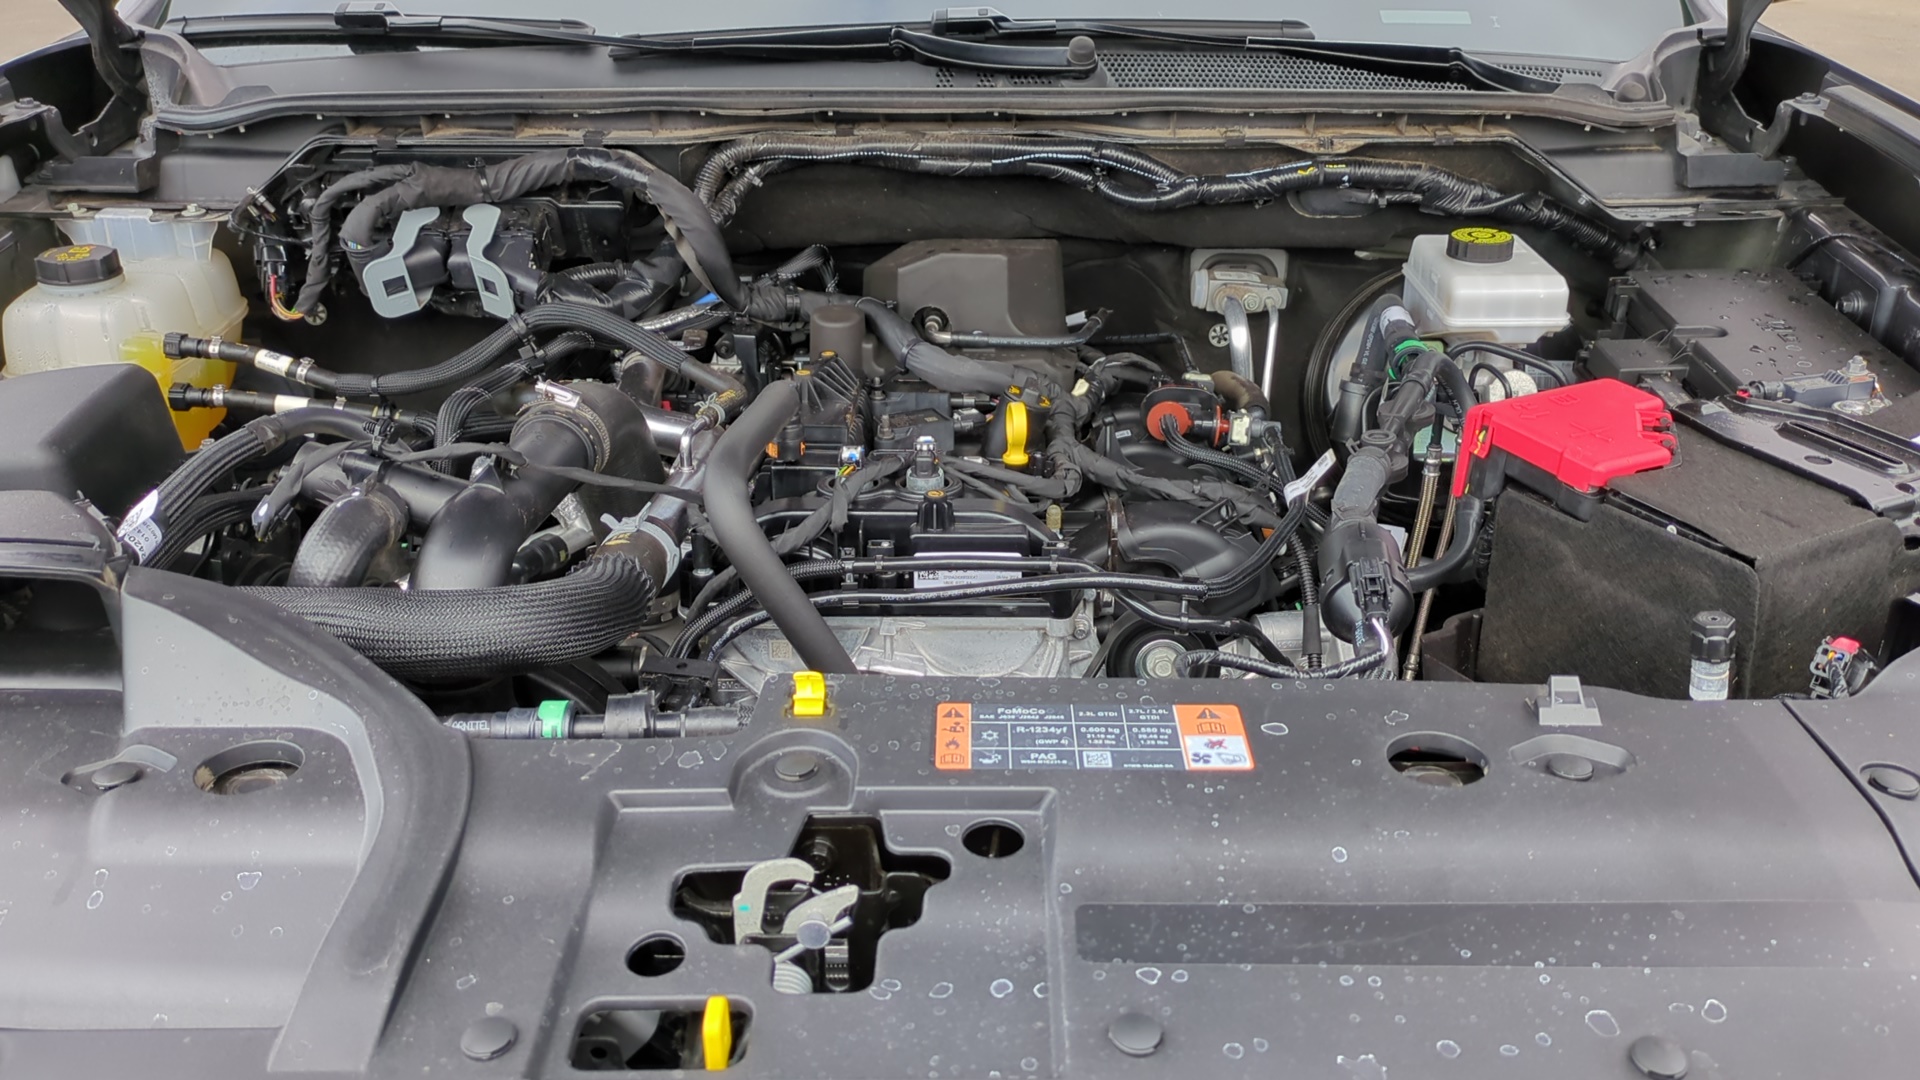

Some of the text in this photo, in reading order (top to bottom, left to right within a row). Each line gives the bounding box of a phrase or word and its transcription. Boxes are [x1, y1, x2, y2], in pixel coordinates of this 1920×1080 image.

[997, 707, 1046, 715] FoMoCo
[1016, 726, 1068, 735] R-1234yf
[1107, 726, 1120, 734] kg
[1030, 752, 1057, 760] PAG
